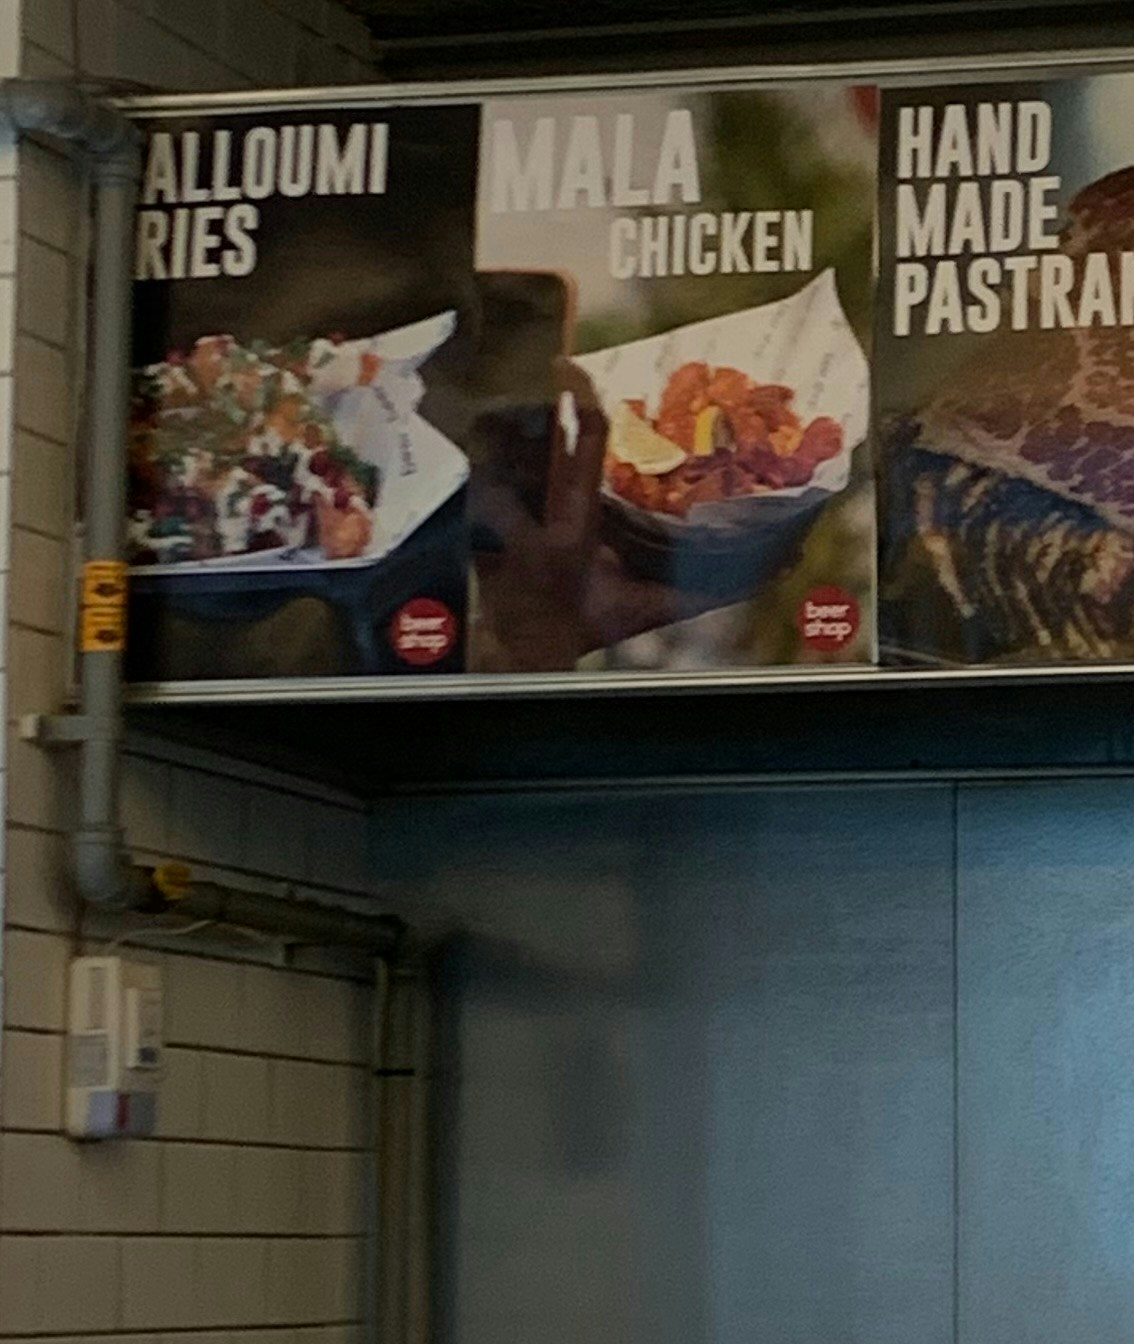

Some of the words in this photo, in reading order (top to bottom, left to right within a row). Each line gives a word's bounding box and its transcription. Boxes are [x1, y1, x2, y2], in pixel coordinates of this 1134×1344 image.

[144, 123, 389, 204] ALLOUMI
[492, 109, 700, 213] MALA
[896, 100, 1052, 179] HAND
[135, 203, 259, 281] RIES
[610, 209, 813, 280] CHICKEN
[895, 176, 1061, 257] MADE
[804, 619, 852, 641] shop
[805, 601, 850, 619] beer
